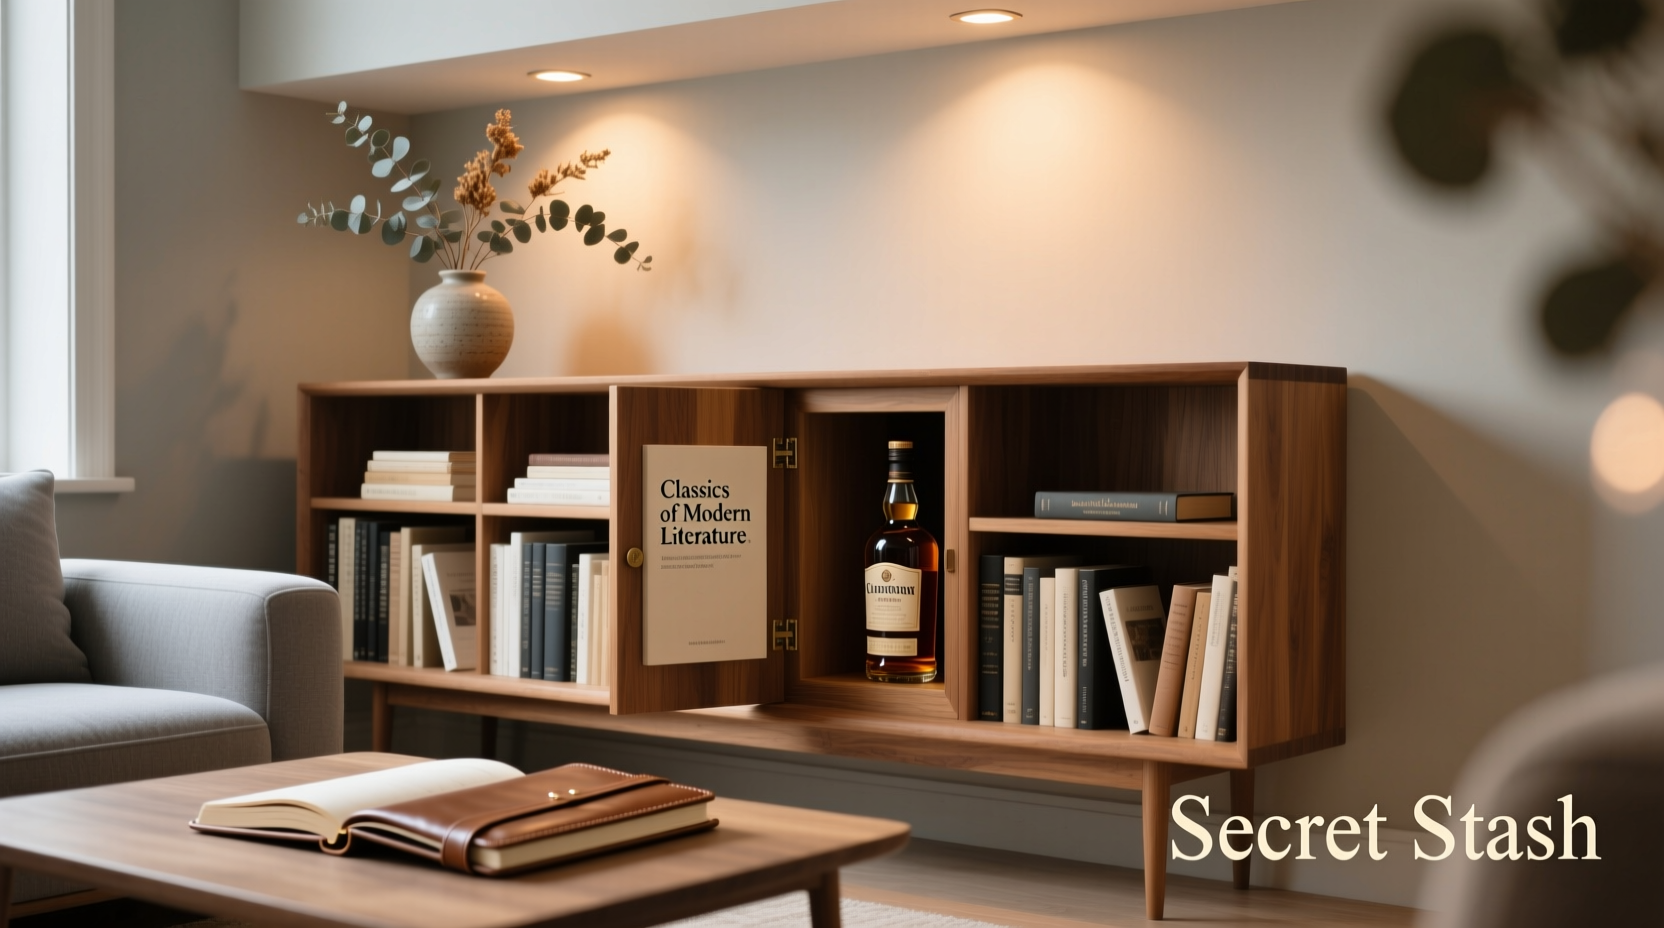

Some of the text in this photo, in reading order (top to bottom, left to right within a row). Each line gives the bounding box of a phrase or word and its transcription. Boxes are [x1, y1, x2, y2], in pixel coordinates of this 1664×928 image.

[660, 478, 730, 499] Classics
[660, 502, 751, 523] of Modern
